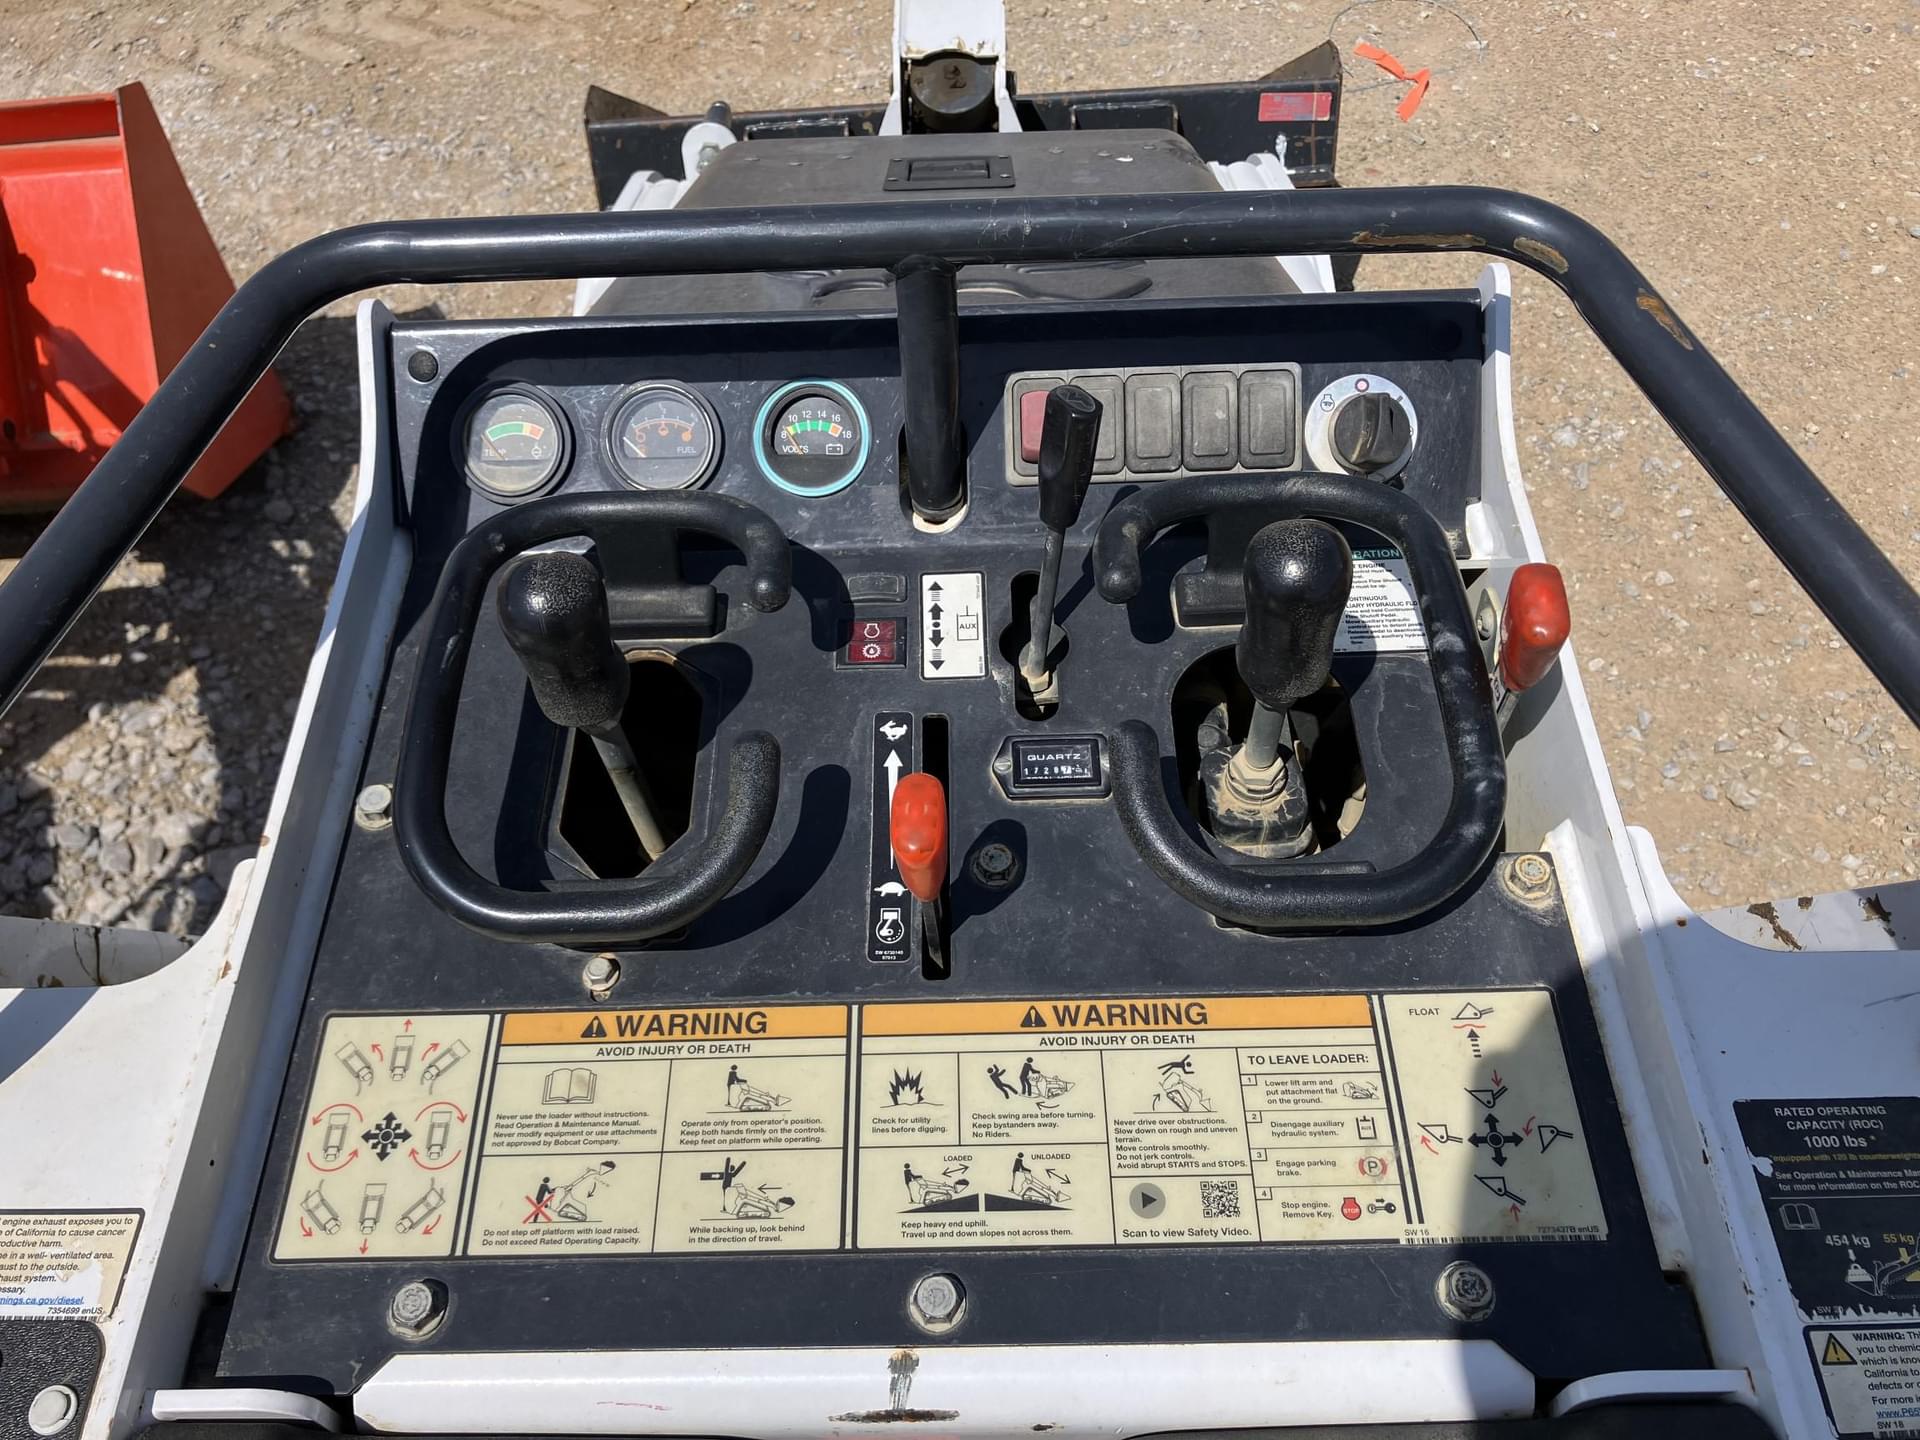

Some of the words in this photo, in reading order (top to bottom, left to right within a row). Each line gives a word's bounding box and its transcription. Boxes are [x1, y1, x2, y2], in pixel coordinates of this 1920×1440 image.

[802, 410, 812, 418] 12
[818, 410, 826, 418] 14
[832, 414, 840, 422] 16
[676, 446, 696, 454] FUEL
[960, 622, 976, 630] AUX
[1052, 1002, 1208, 1027] WARNING
[1409, 1008, 1439, 1016] FLOAT
[616, 1011, 767, 1037] WARNING
[1040, 1036, 1077, 1046] AVOID
[1081, 1035, 1127, 1046] INJURY
[1131, 1035, 1149, 1045] OR
[1153, 1035, 1195, 1044] DEATH
[596, 1047, 635, 1056] AVOID
[638, 1045, 684, 1055] INJURY
[687, 1045, 705, 1054] OR
[709, 1043, 751, 1054] DEATH
[1247, 1056, 1265, 1065] TO
[1269, 1055, 1309, 1065] LEAVE
[1312, 1054, 1368, 1064] LOADER:
[998, 1112, 1020, 1120] swing
[1774, 1107, 1814, 1116] RATED
[1817, 1106, 1886, 1116] OPERATING
[917, 1125, 948, 1134] digging.
[972, 1122, 992, 1130] Keep
[1786, 1120, 1845, 1130] CAPACITY
[1849, 1120, 1884, 1131] (ROC)
[1169, 1127, 1192, 1135] rough
[1803, 1136, 1840, 1148] 1000
[1842, 1135, 1867, 1147] lbs
[1172, 1144, 1209, 1152] smoothly.
[1144, 1153, 1159, 1161] jerk
[1160, 1152, 1194, 1160] controls.
[1141, 1162, 1166, 1170] abrupt
[1218, 1160, 1247, 1168] STOPS.
[2, 1218, 31, 1227] engine
[68, 1218, 104, 1227] exposes
[105, 1218, 122, 1227] you
[124, 1217, 133, 1225] to
[901, 1221, 922, 1229] Keep
[923, 1221, 946, 1229] heavy
[948, 1220, 963, 1228] end
[964, 1220, 988, 1228] uphill.
[4, 1228, 15, 1236] of
[15, 1228, 56, 1236] California
[689, 1226, 711, 1234] While
[712, 1226, 744, 1234] backing
[939, 1230, 954, 1238] and
[979, 1229, 1005, 1238] slopes
[1050, 1228, 1072, 1236] them.
[1122, 1229, 1148, 1238] Scan
[1149, 1229, 1160, 1237] to
[1162, 1228, 1185, 1237] view
[1188, 1228, 1218, 1238] Safety
[1221, 1227, 1252, 1236] Video.
[39, 1239, 63, 1247] harm.
[712, 1235, 747, 1243] direction
[1826, 1235, 1849, 1246] 454
[1852, 1234, 1871, 1248] kg
[1883, 1234, 1897, 1243] 55
[1899, 1233, 1915, 1245] kg
[9, 1251, 18, 1259] in
[50, 1250, 93, 1260] ventilated
[19, 1263, 28, 1271] to
[30, 1262, 44, 1271] the
[46, 1262, 80, 1271] outside.
[24, 1274, 56, 1283] system.
[47, 1307, 80, 1315] 7354699
[1852, 1332, 1905, 1341] WARNING:
[1856, 1347, 1874, 1356] you
[1875, 1345, 1886, 1353] to
[1860, 1357, 1888, 1366] which
[1889, 1356, 1899, 1365] is
[1864, 1368, 1909, 1378] California
[1868, 1381, 1903, 1391] defects
[1871, 1396, 1887, 1405] For
[1876, 1407, 1920, 1419] www.P65
